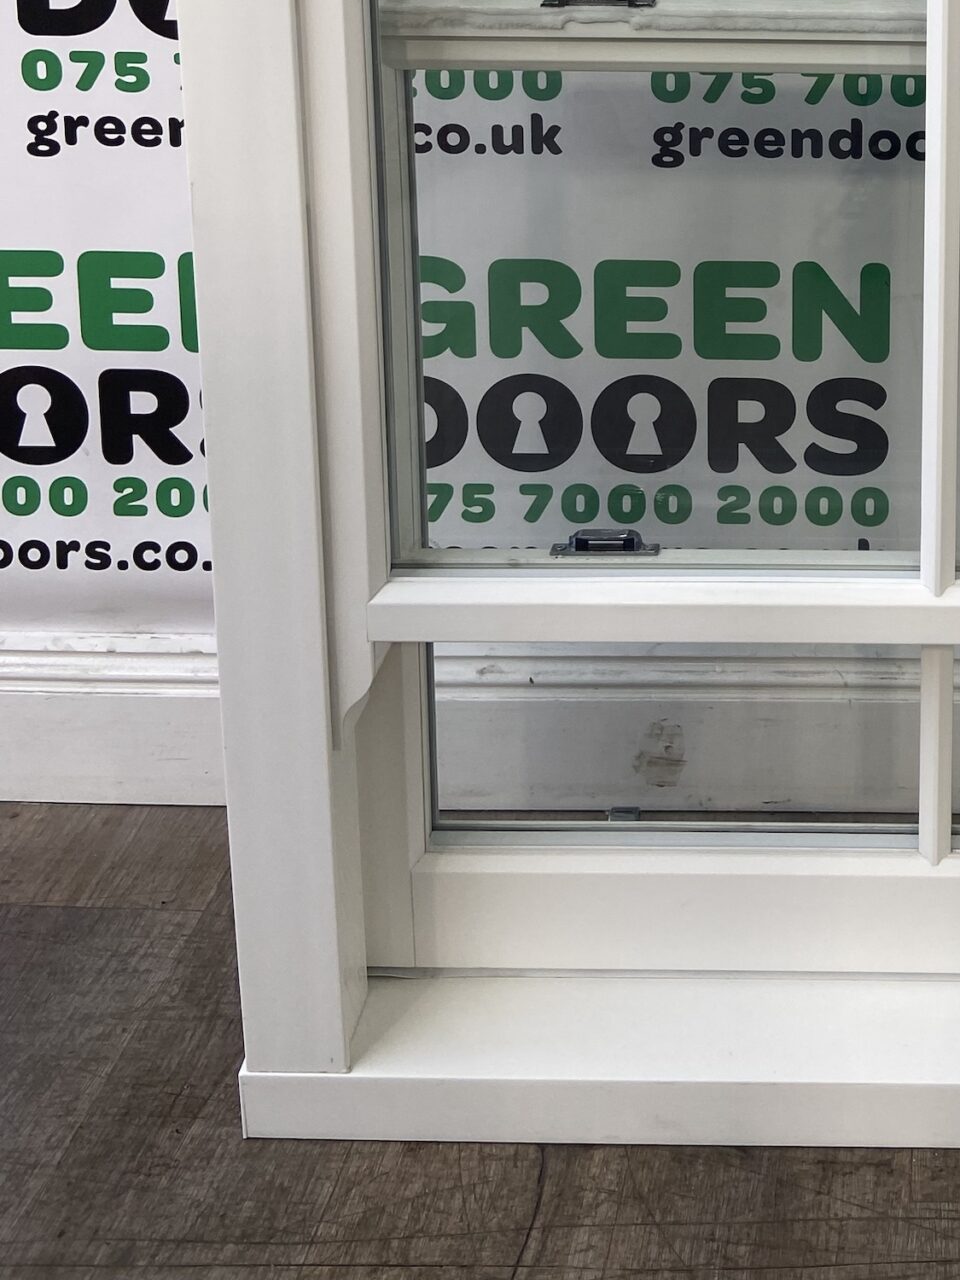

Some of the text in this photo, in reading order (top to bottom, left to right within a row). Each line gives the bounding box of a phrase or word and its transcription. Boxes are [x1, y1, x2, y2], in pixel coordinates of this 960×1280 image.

[21, 49, 150, 92] 075
[518, 483, 693, 524] 7000
[716, 485, 889, 527] 2000
